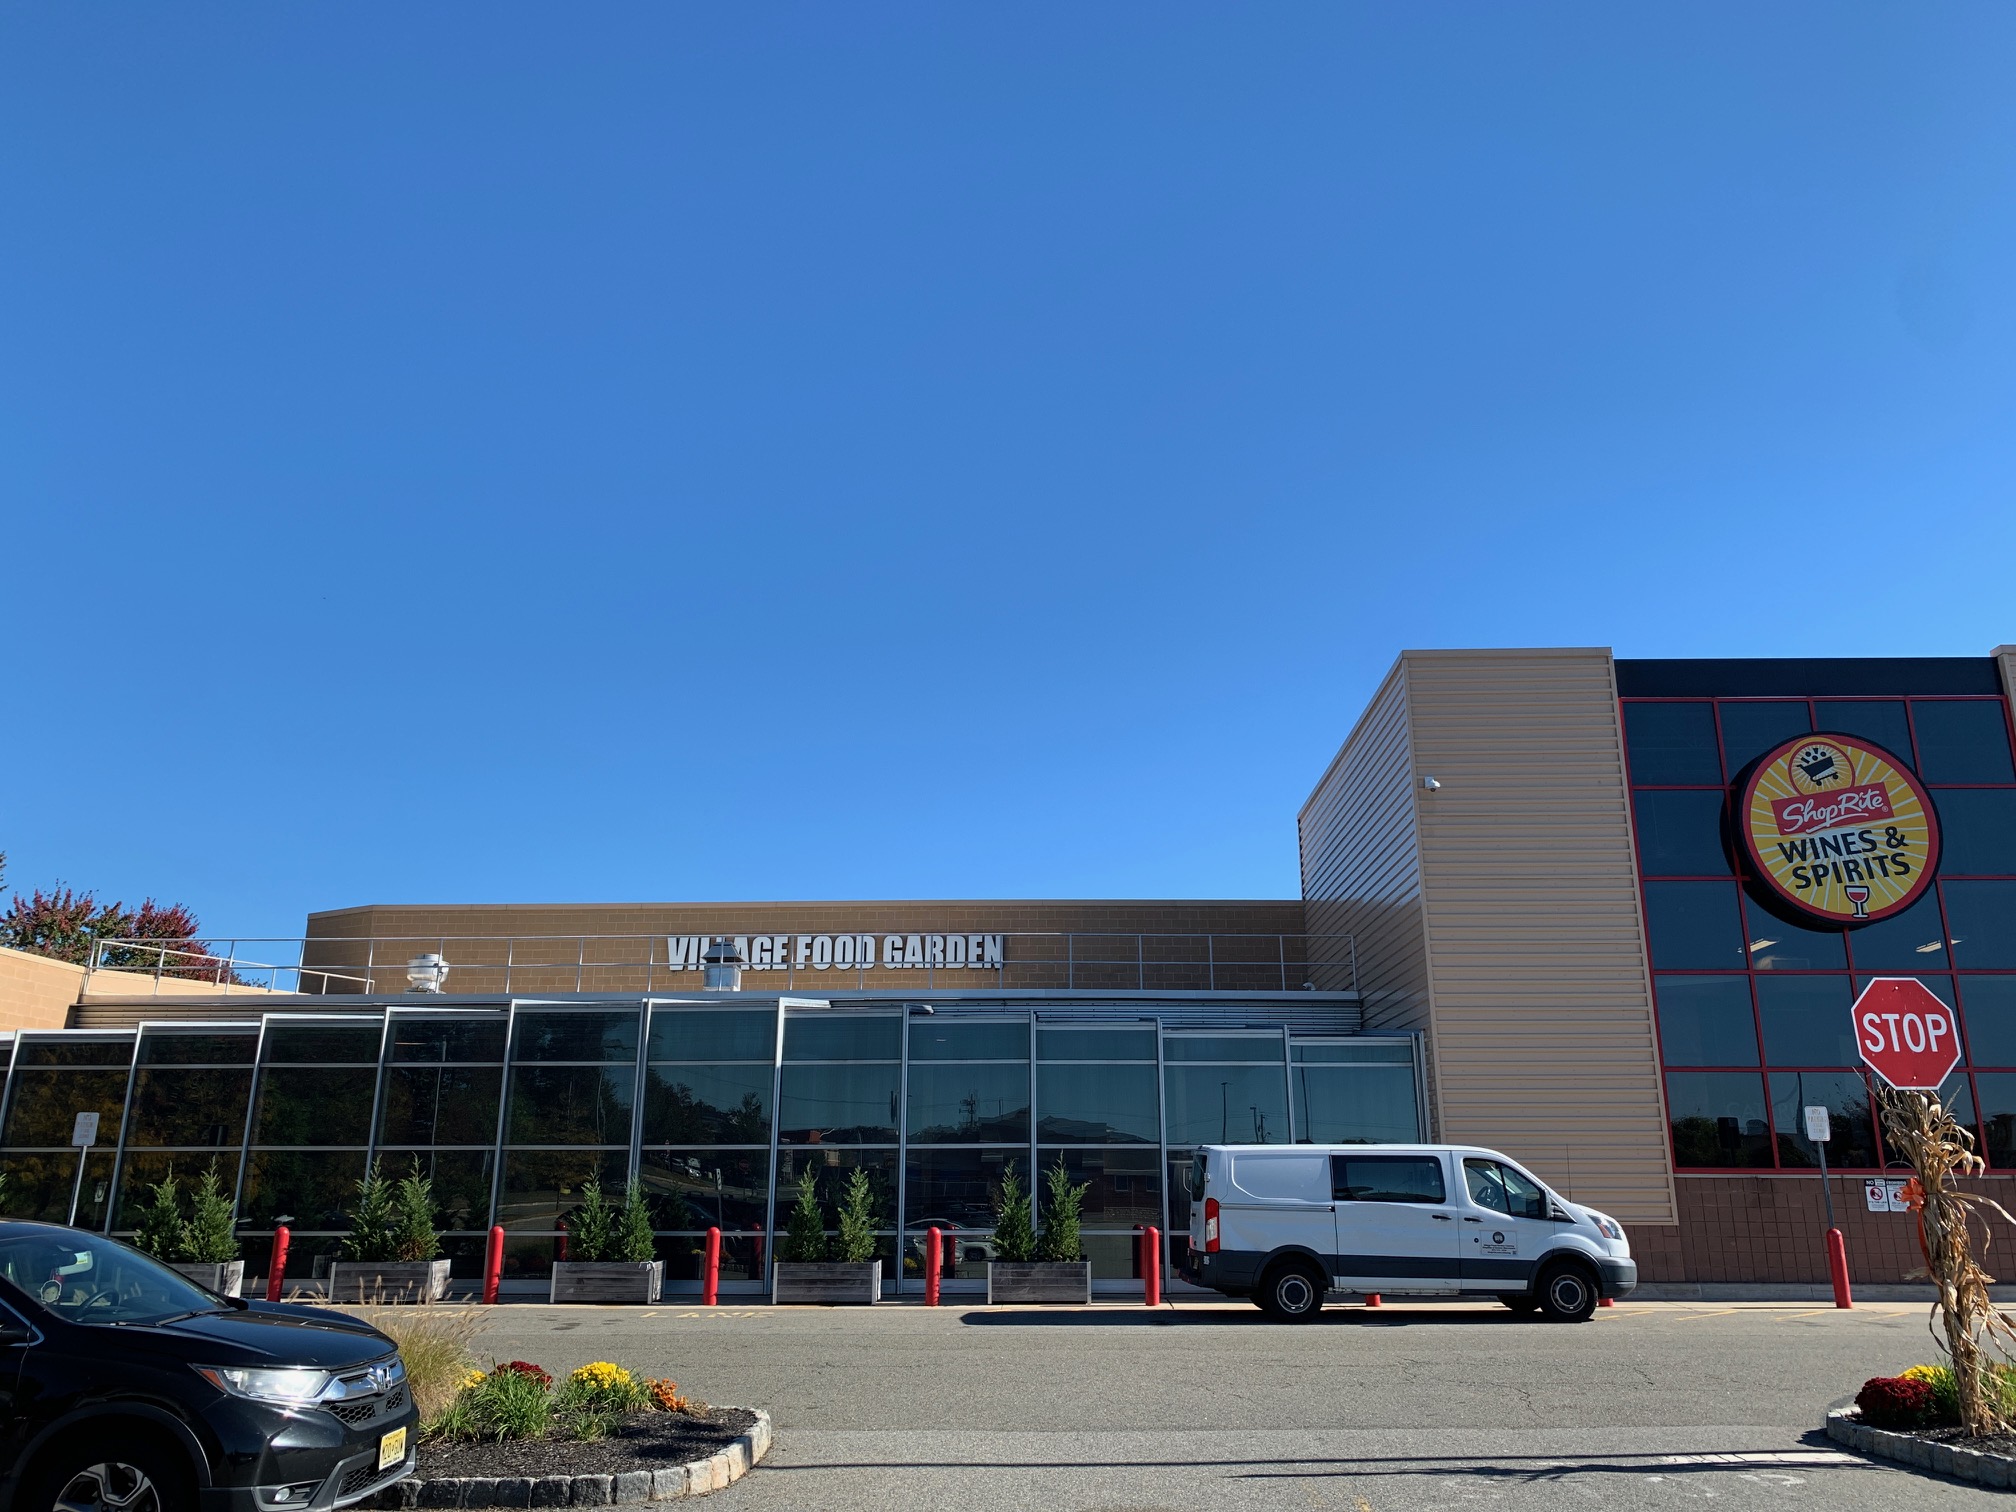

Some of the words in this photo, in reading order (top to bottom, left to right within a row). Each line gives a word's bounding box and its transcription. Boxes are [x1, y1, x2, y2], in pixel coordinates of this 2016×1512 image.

[1782, 788, 1884, 833] ShopRite
[1776, 829, 1878, 864] WINES
[1885, 826, 1909, 849] &
[1792, 852, 1911, 889] SPIRITS
[667, 936, 789, 971] VILAGE
[795, 935, 875, 970] FOOD
[882, 935, 1003, 970] GARDEN
[1862, 1012, 1948, 1053] STOP
